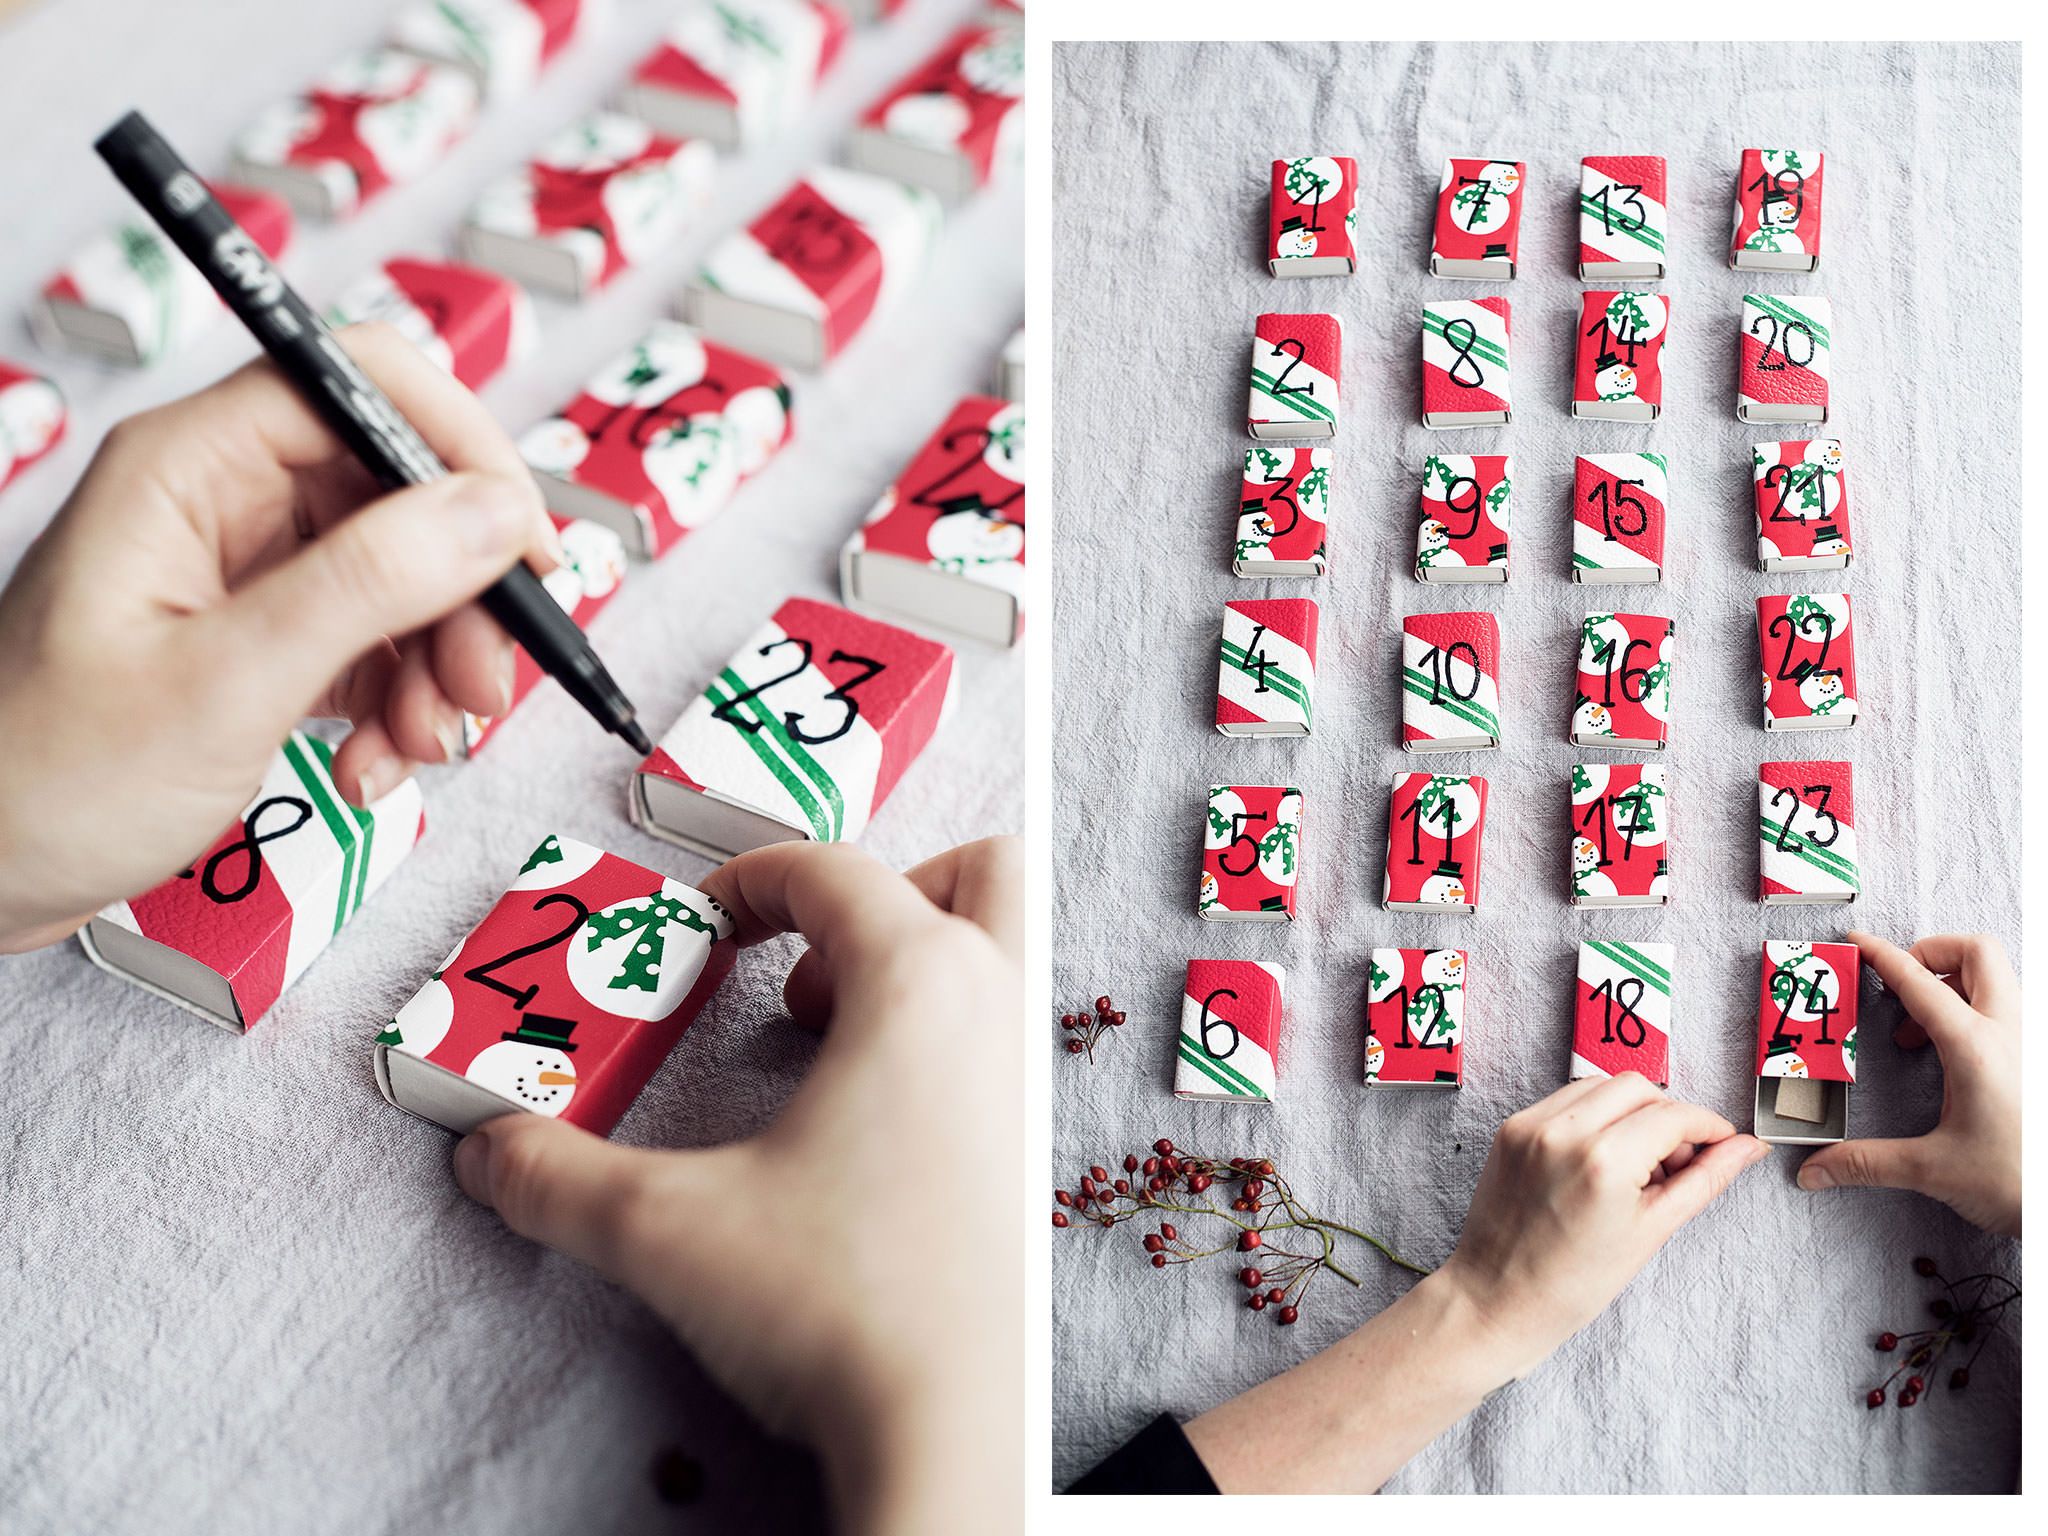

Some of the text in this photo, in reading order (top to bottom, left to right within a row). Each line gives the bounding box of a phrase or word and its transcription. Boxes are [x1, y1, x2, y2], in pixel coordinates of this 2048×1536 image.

[1292, 180, 1326, 232] 1
[1459, 176, 1491, 231] 7
[1588, 183, 1646, 236] 13
[1747, 168, 1804, 225] 19
[1270, 338, 1314, 396] 2
[1443, 318, 1484, 388] 8
[1586, 315, 1647, 370] 14
[1751, 314, 1815, 371] 20
[1251, 474, 1298, 537] 3
[1435, 476, 1481, 539] 9
[1588, 479, 1647, 541] 15
[1763, 464, 1832, 526] 21
[1241, 625, 1279, 693] 4
[1418, 641, 1481, 705] 10
[1592, 638, 1652, 707] 16
[1769, 612, 1843, 682] 22
[710, 637, 887, 745] 23
[176, 795, 313, 904] 8
[1218, 810, 1268, 877] 5
[1400, 797, 1456, 864] 11
[1582, 794, 1649, 866] 17
[1770, 785, 1839, 853] 23
[464, 893, 589, 1011] 2
[1200, 988, 1240, 1060] 6
[1382, 983, 1454, 1054] 12
[1588, 977, 1646, 1048] 18
[1768, 968, 1840, 1045] 24
